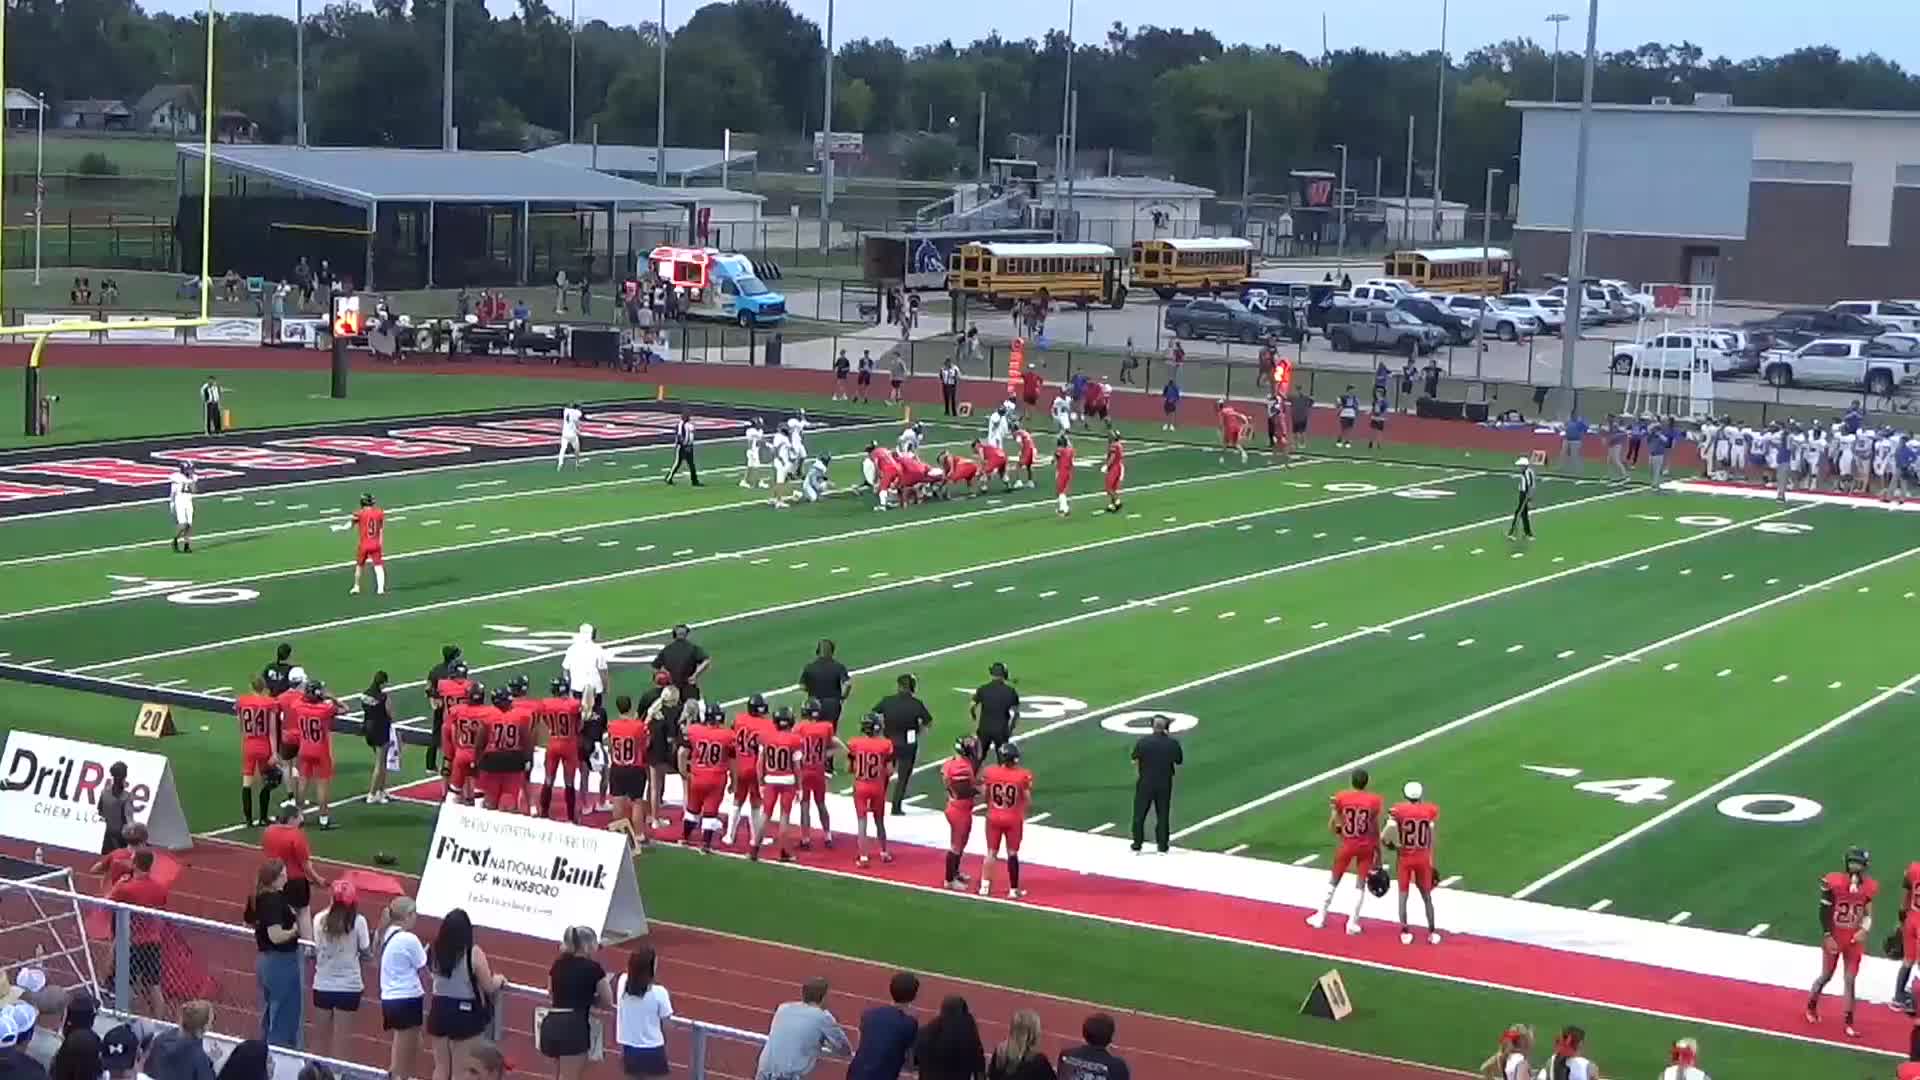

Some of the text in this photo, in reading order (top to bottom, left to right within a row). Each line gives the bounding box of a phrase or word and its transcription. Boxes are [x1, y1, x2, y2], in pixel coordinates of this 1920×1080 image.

[140, 709, 162, 732] 20
[241, 708, 267, 733] 24
[493, 723, 520, 749] 79
[802, 735, 824, 763] 14
[610, 736, 636, 764] 58
[856, 753, 881, 779] 12
[992, 783, 1017, 809] 69
[34, 802, 71, 820] CHEM
[1343, 807, 1369, 837] 33
[1403, 818, 1431, 848] 20
[435, 835, 608, 890] First NATIONAL Bank
[473, 871, 560, 899] OF WINNSBORO
